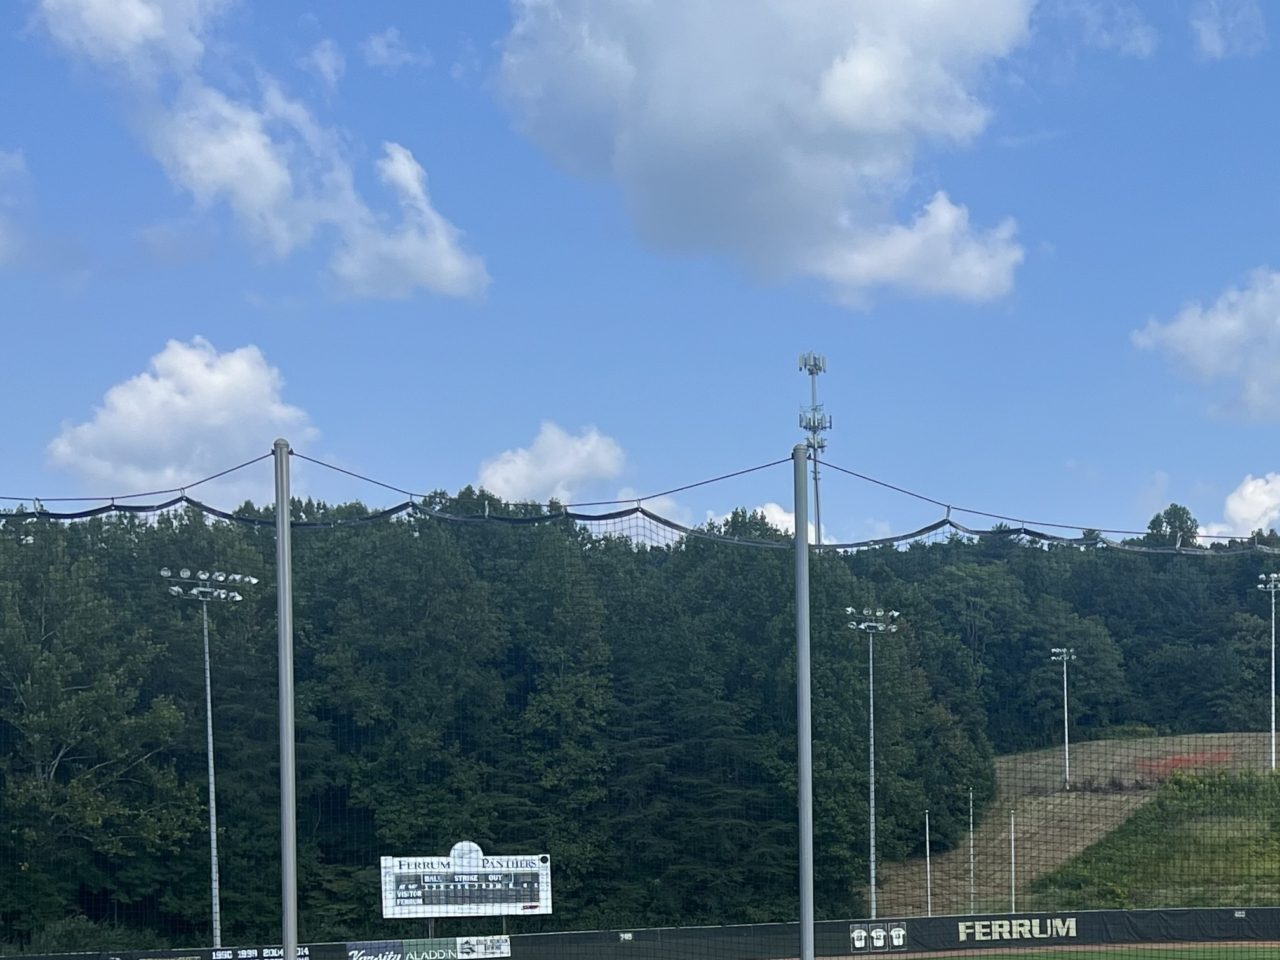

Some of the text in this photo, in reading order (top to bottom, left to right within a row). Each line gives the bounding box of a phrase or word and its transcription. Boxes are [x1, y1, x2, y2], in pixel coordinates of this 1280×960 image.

[398, 857, 537, 870] FERRUM PANTHERS
[454, 874, 479, 882] STRIKE
[396, 890, 423, 898] VISITOR
[958, 917, 1077, 942] FERRUM
[262, 948, 284, 958] 2004
[296, 946, 310, 956] 014
[405, 949, 457, 960] ALADDIN
